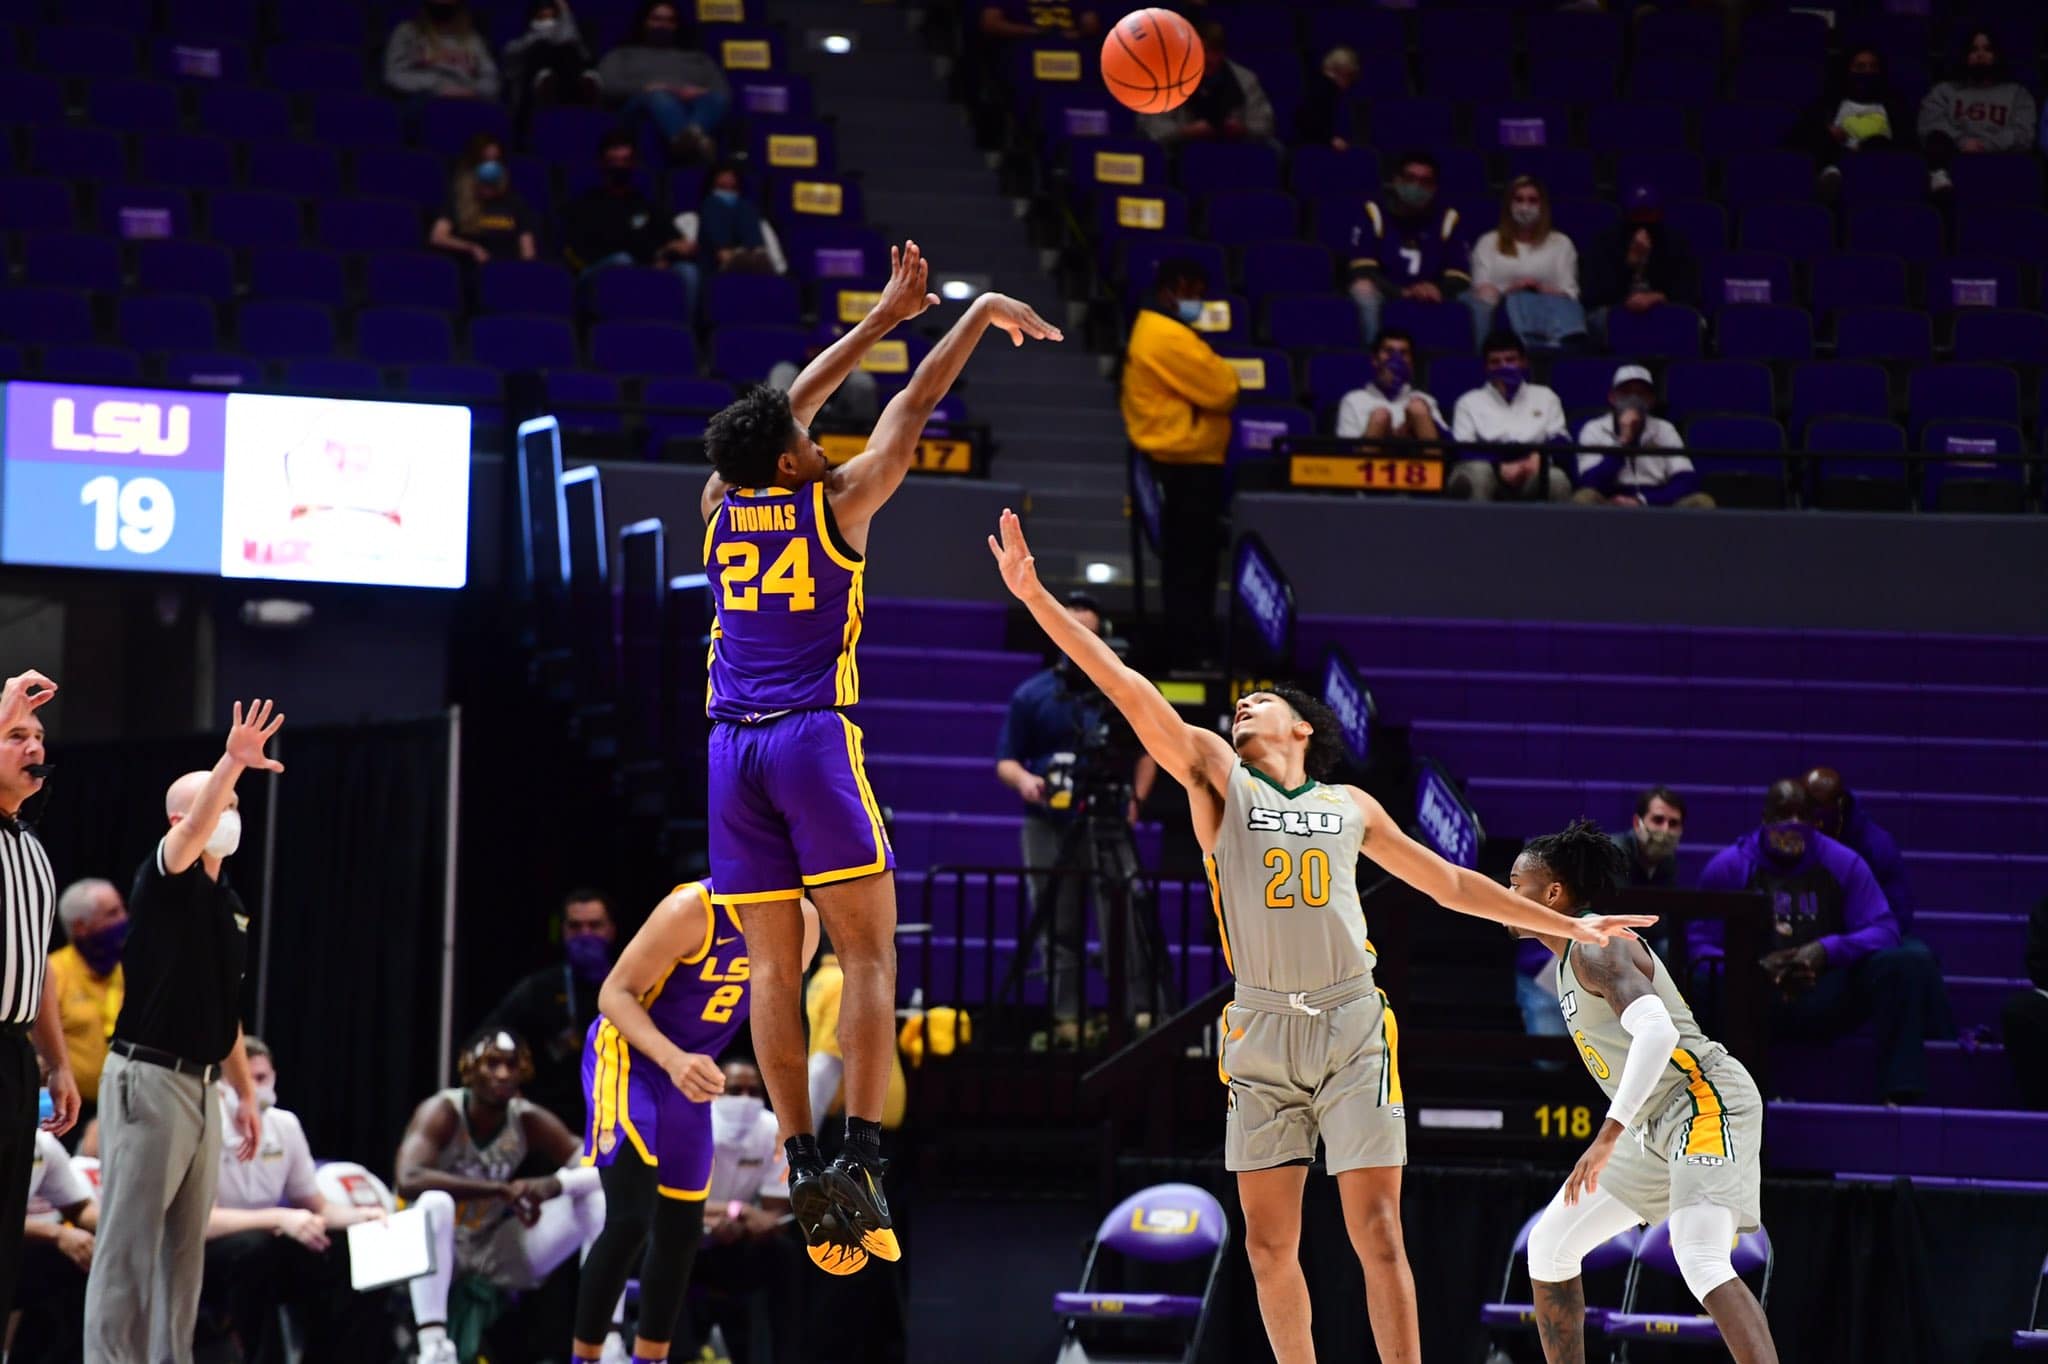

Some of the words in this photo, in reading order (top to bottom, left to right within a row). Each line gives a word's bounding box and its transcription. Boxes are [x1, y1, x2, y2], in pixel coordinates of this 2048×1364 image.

[1398, 246, 1422, 276] 7
[52, 397, 190, 456] LSU
[915, 444, 954, 470] 17
[1357, 460, 1428, 488] 118
[80, 475, 176, 555] 19
[728, 504, 797, 532] THOMAS
[715, 537, 816, 612] 24
[1248, 806, 1343, 837] SLU
[1263, 847, 1332, 909] 20
[698, 956, 750, 983] LS
[701, 984, 744, 1024] 2
[1391, 1107, 1406, 1119] S
[1534, 1104, 1593, 1139] 118
[1687, 1155, 1724, 1167] SLU
[1131, 1207, 1200, 1235] LSU
[1644, 1320, 1680, 1336] LSU
